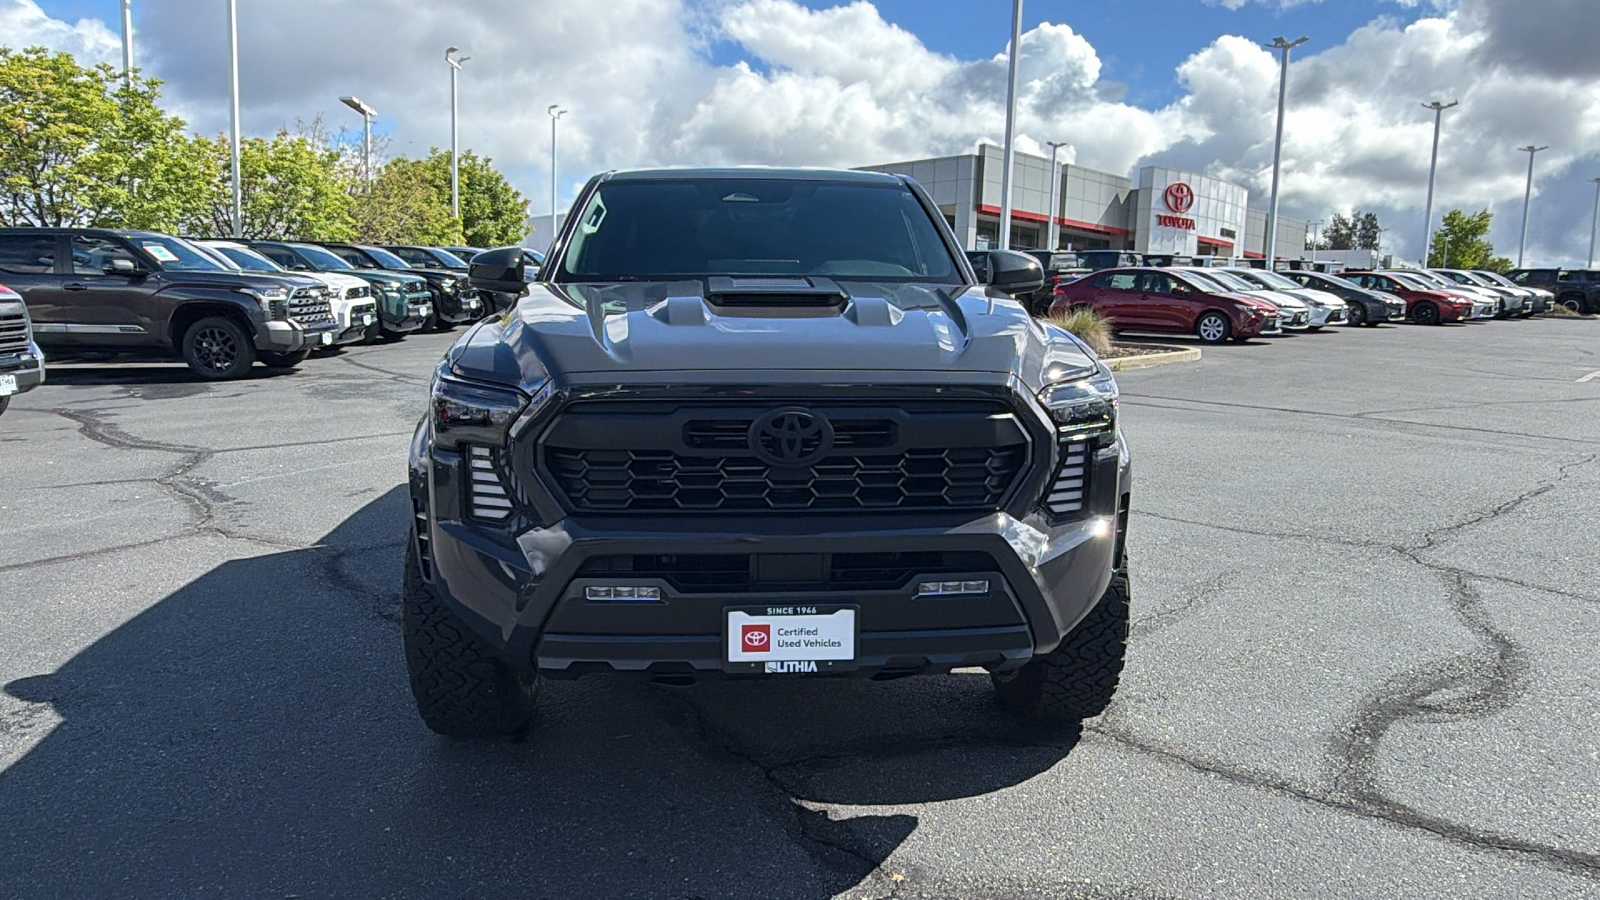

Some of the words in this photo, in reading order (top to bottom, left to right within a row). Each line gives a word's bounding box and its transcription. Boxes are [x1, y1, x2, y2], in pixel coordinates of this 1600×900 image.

[1156, 214, 1195, 230] TOYOTA
[766, 607, 794, 615] SINCE
[796, 606, 817, 614] 1946
[777, 628, 818, 636] Certified
[777, 639, 802, 648] Used
[803, 639, 842, 648] Vehicles
[776, 661, 818, 673] LITHIA
